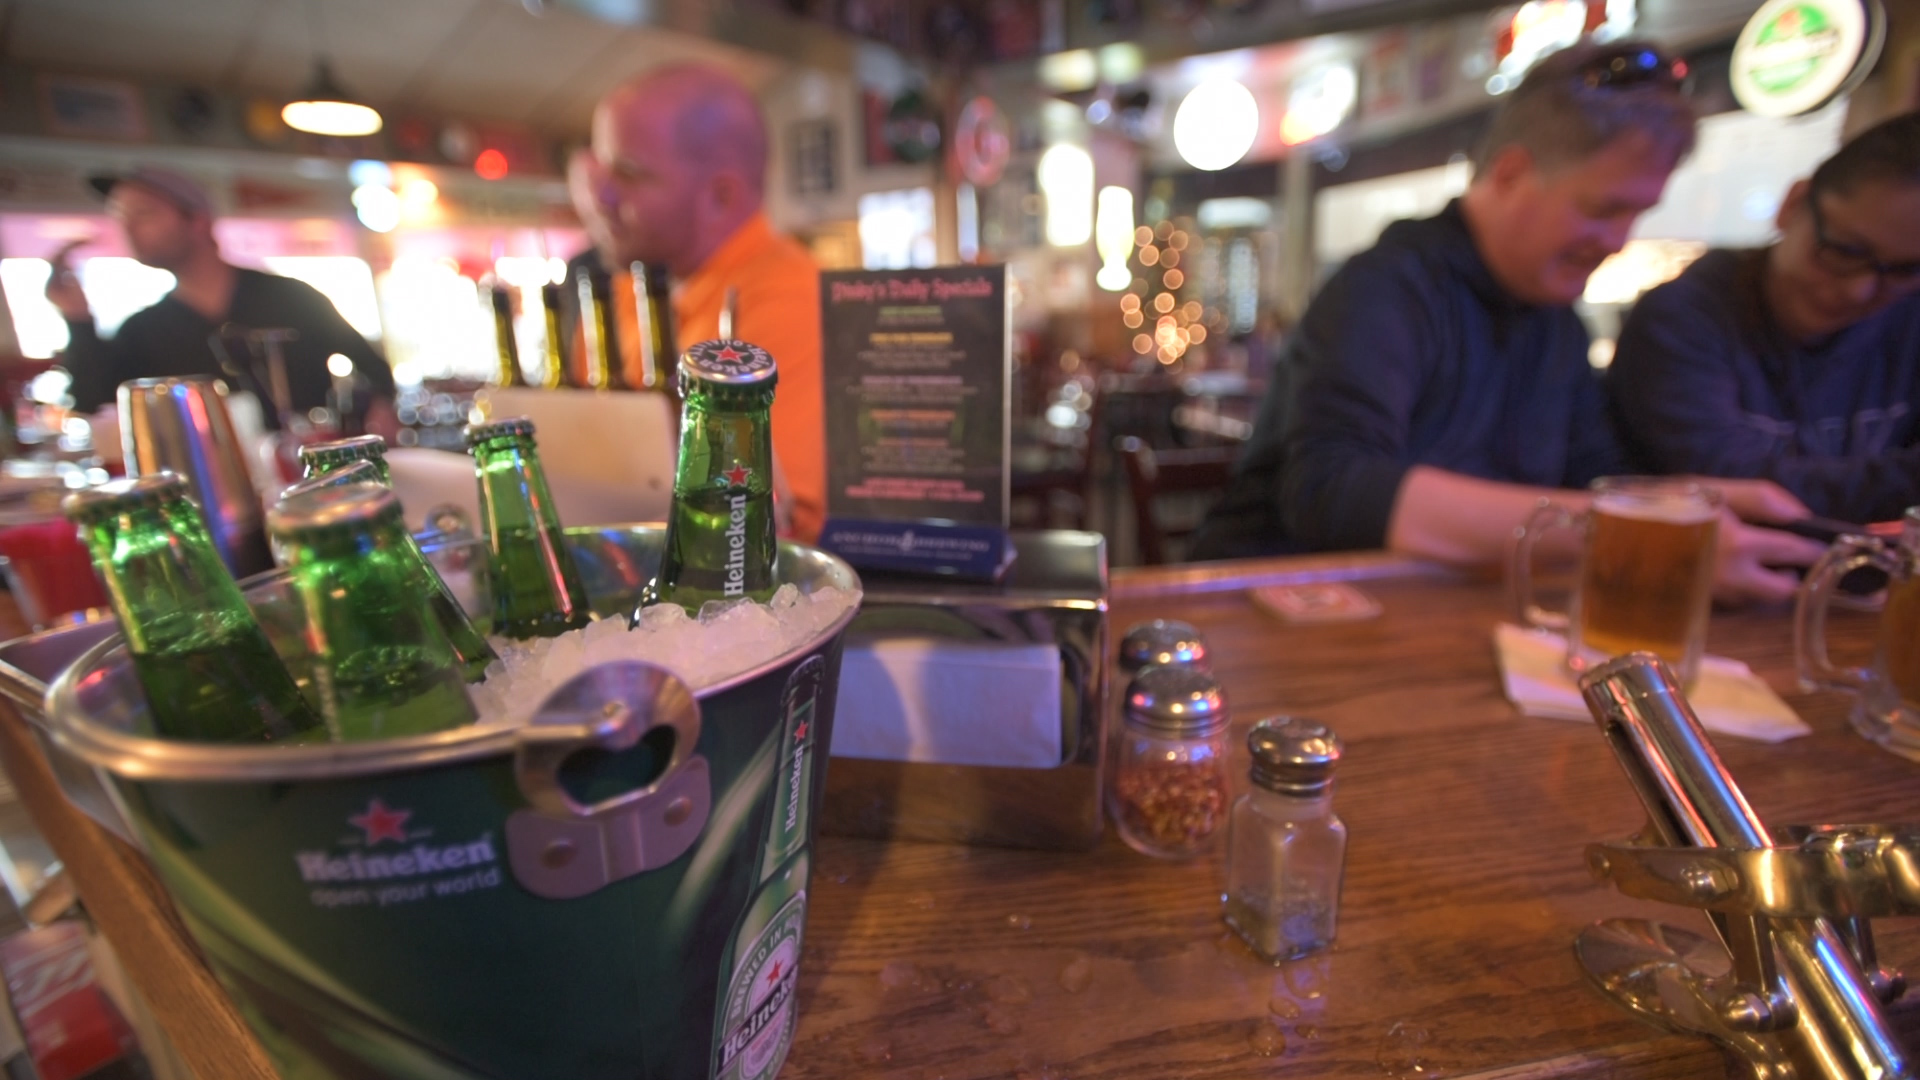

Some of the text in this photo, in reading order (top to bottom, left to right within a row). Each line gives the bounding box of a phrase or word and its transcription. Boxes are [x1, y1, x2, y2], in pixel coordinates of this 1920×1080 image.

[889, 278, 929, 303] Daily
[932, 276, 993, 301] Specials
[699, 348, 770, 375] Heineken
[724, 494, 747, 596] Heineken
[784, 745, 804, 833] Heineken
[296, 840, 495, 881] Heineken
[311, 867, 500, 906] open your world
[731, 950, 767, 1019] BREWED
[769, 927, 782, 948] IN
